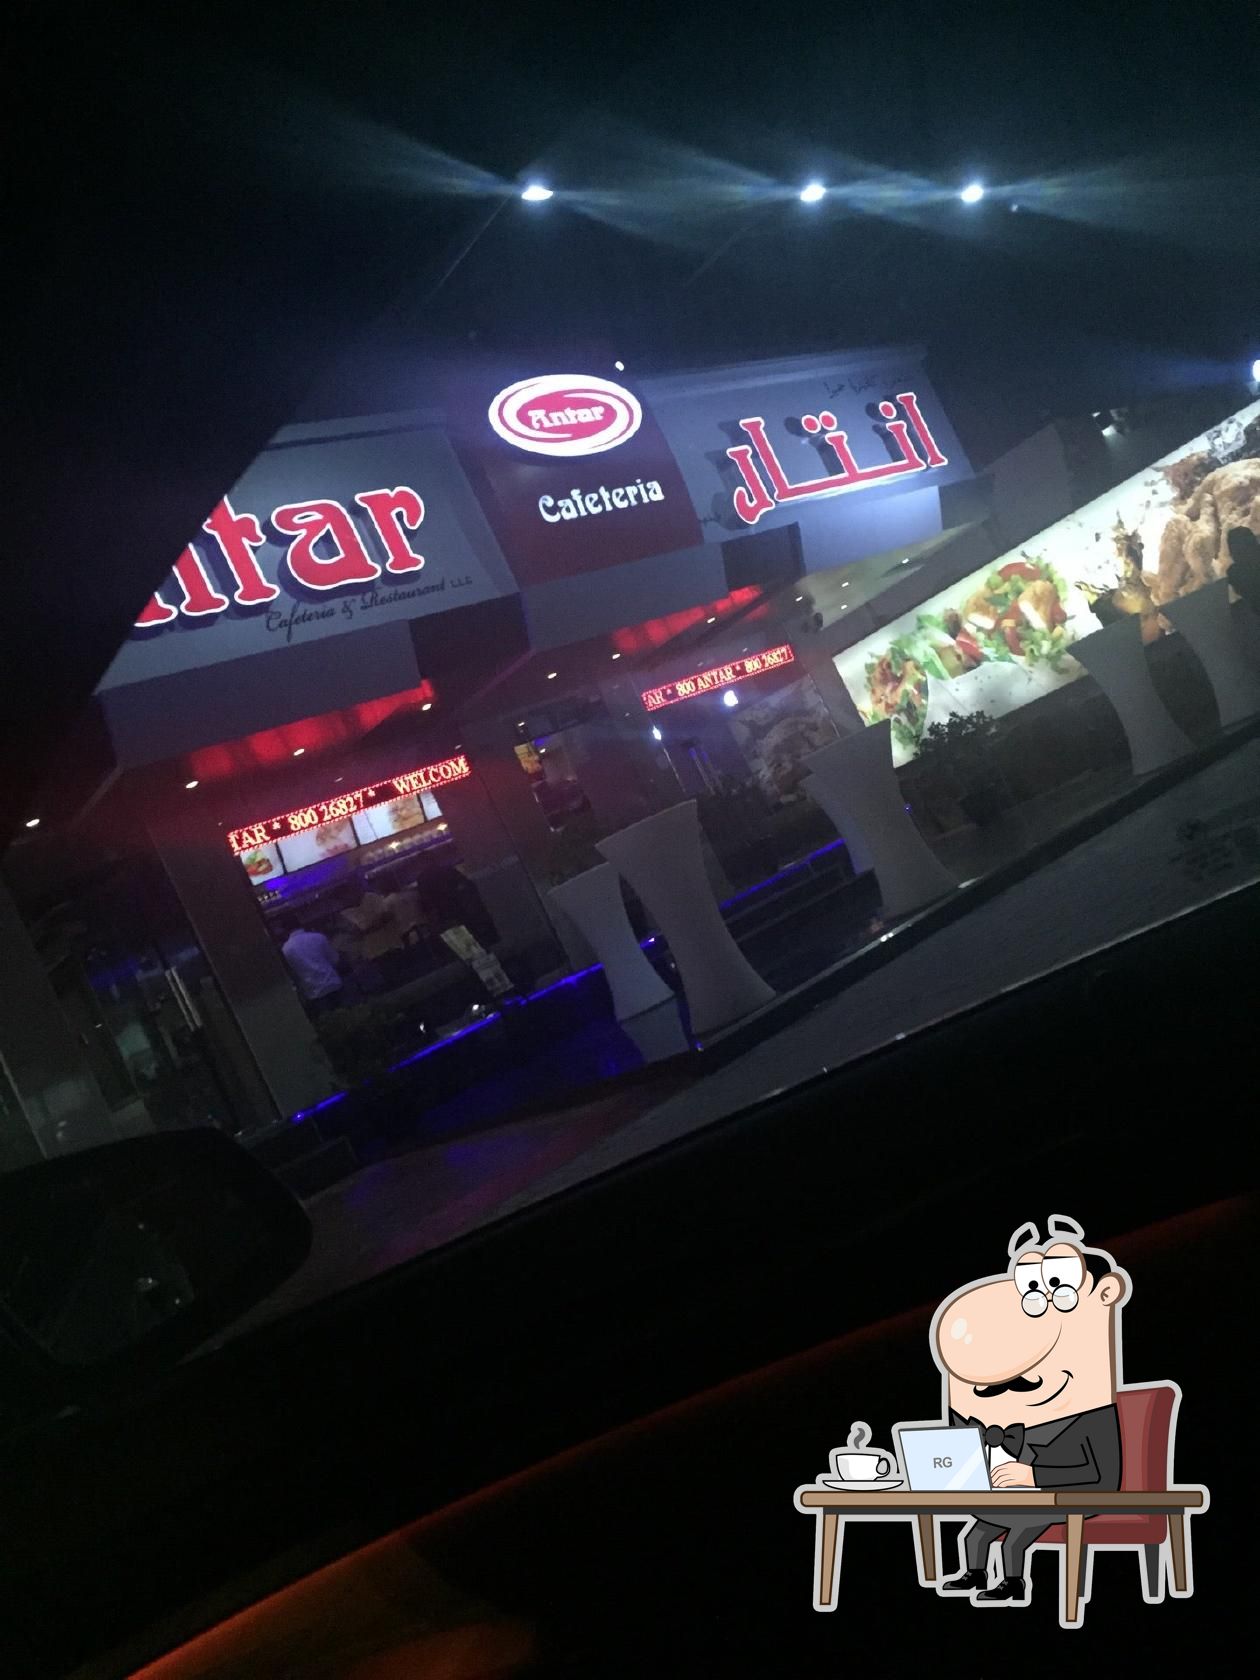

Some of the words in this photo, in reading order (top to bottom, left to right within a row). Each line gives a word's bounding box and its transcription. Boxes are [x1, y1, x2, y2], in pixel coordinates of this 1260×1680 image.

[528, 405, 605, 430] Antar
[538, 478, 665, 523] Cafeteria
[266, 600, 337, 642] Cafeteria
[341, 599, 357, 620] &
[360, 576, 446, 611] Restaurant
[675, 679, 696, 697] 800
[697, 666, 737, 690] ANTAR
[744, 657, 762, 673] 800
[287, 807, 319, 832] 800
[319, 791, 365, 822] 26827
[392, 756, 470, 796] WELCOM
